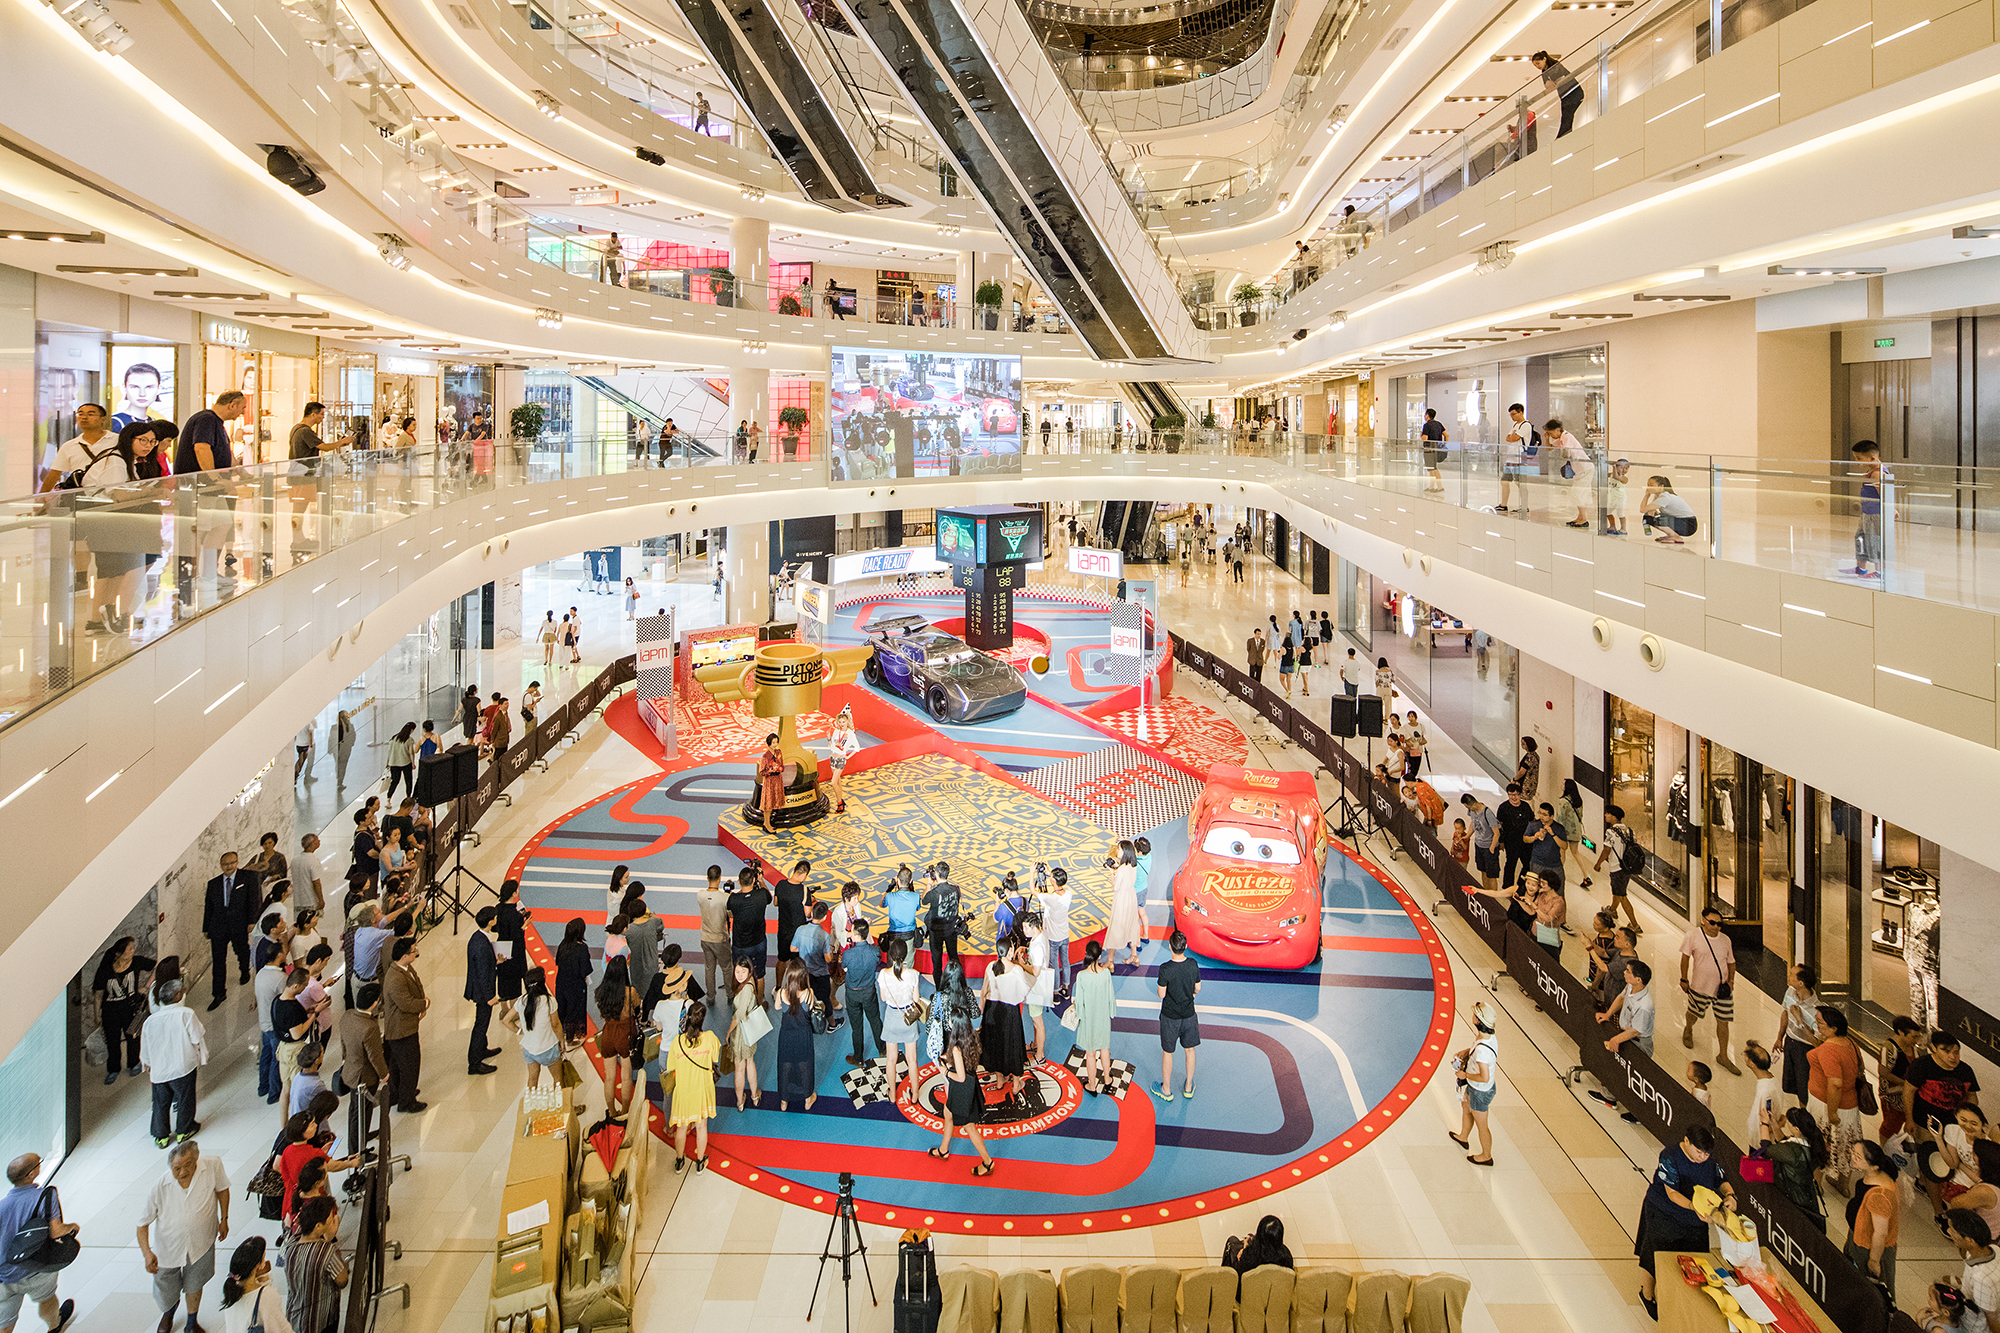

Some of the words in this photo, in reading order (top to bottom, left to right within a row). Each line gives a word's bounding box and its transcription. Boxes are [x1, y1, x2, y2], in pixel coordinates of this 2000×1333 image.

[862, 556, 883, 574] RACE
[882, 552, 911, 571] READY
[1077, 550, 1110, 573] iapm
[961, 566, 975, 576] LAP
[996, 566, 1014, 577] LAP
[963, 577, 973, 587] 88
[999, 577, 1012, 587] 88
[1113, 633, 1138, 649] iapm
[639, 647, 668, 663] iapm
[783, 660, 819, 675] PISTON
[791, 671, 814, 685] CUP
[786, 793, 813, 804] CHAMPION
[1002, 804, 1051, 820] 95
[1536, 963, 1569, 1014] iapm
[1627, 1061, 1673, 1127] iapm
[904, 1106, 945, 1131] PISTO
[999, 1102, 1076, 1136] CHAMPION
[1767, 1209, 1826, 1303] iapm
